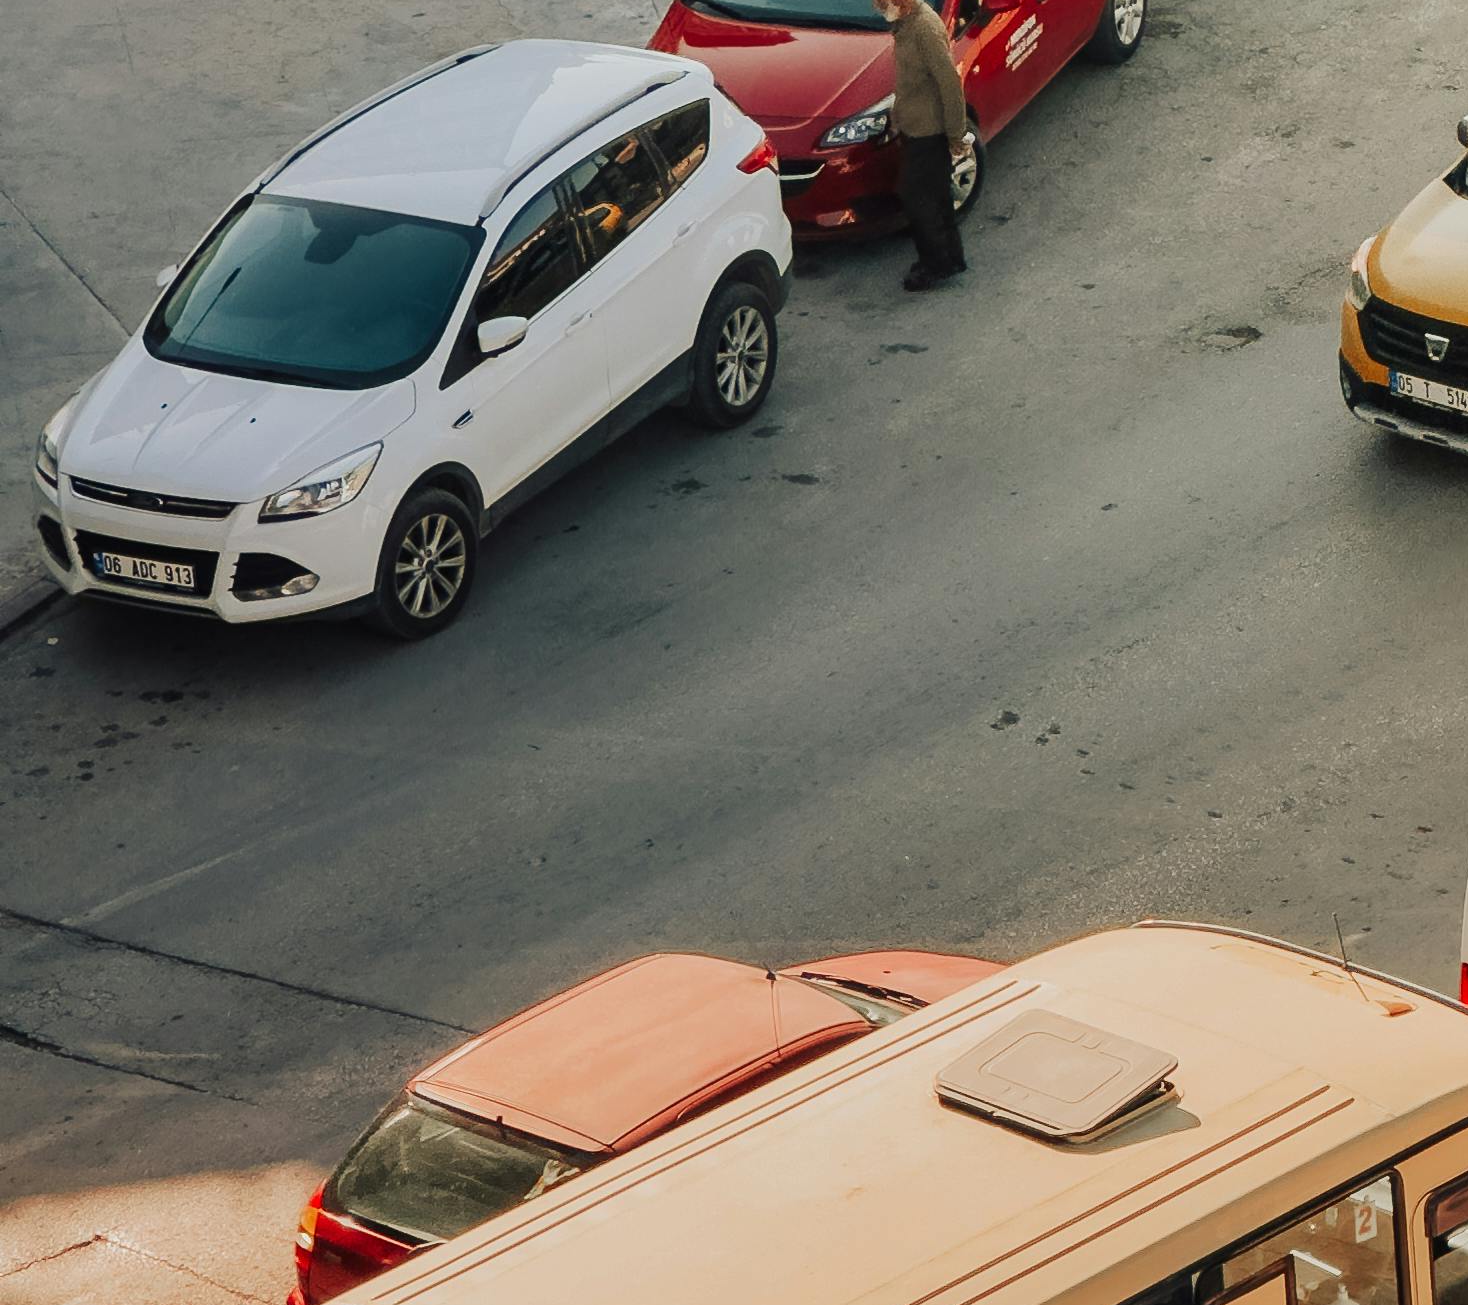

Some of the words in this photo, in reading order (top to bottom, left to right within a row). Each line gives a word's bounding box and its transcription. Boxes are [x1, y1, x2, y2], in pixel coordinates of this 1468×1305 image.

[1399, 375, 1412, 393] 05
[1424, 382, 1431, 398] T
[104, 556, 121, 573] 06
[133, 560, 157, 579] ADC
[165, 565, 191, 584] 913
